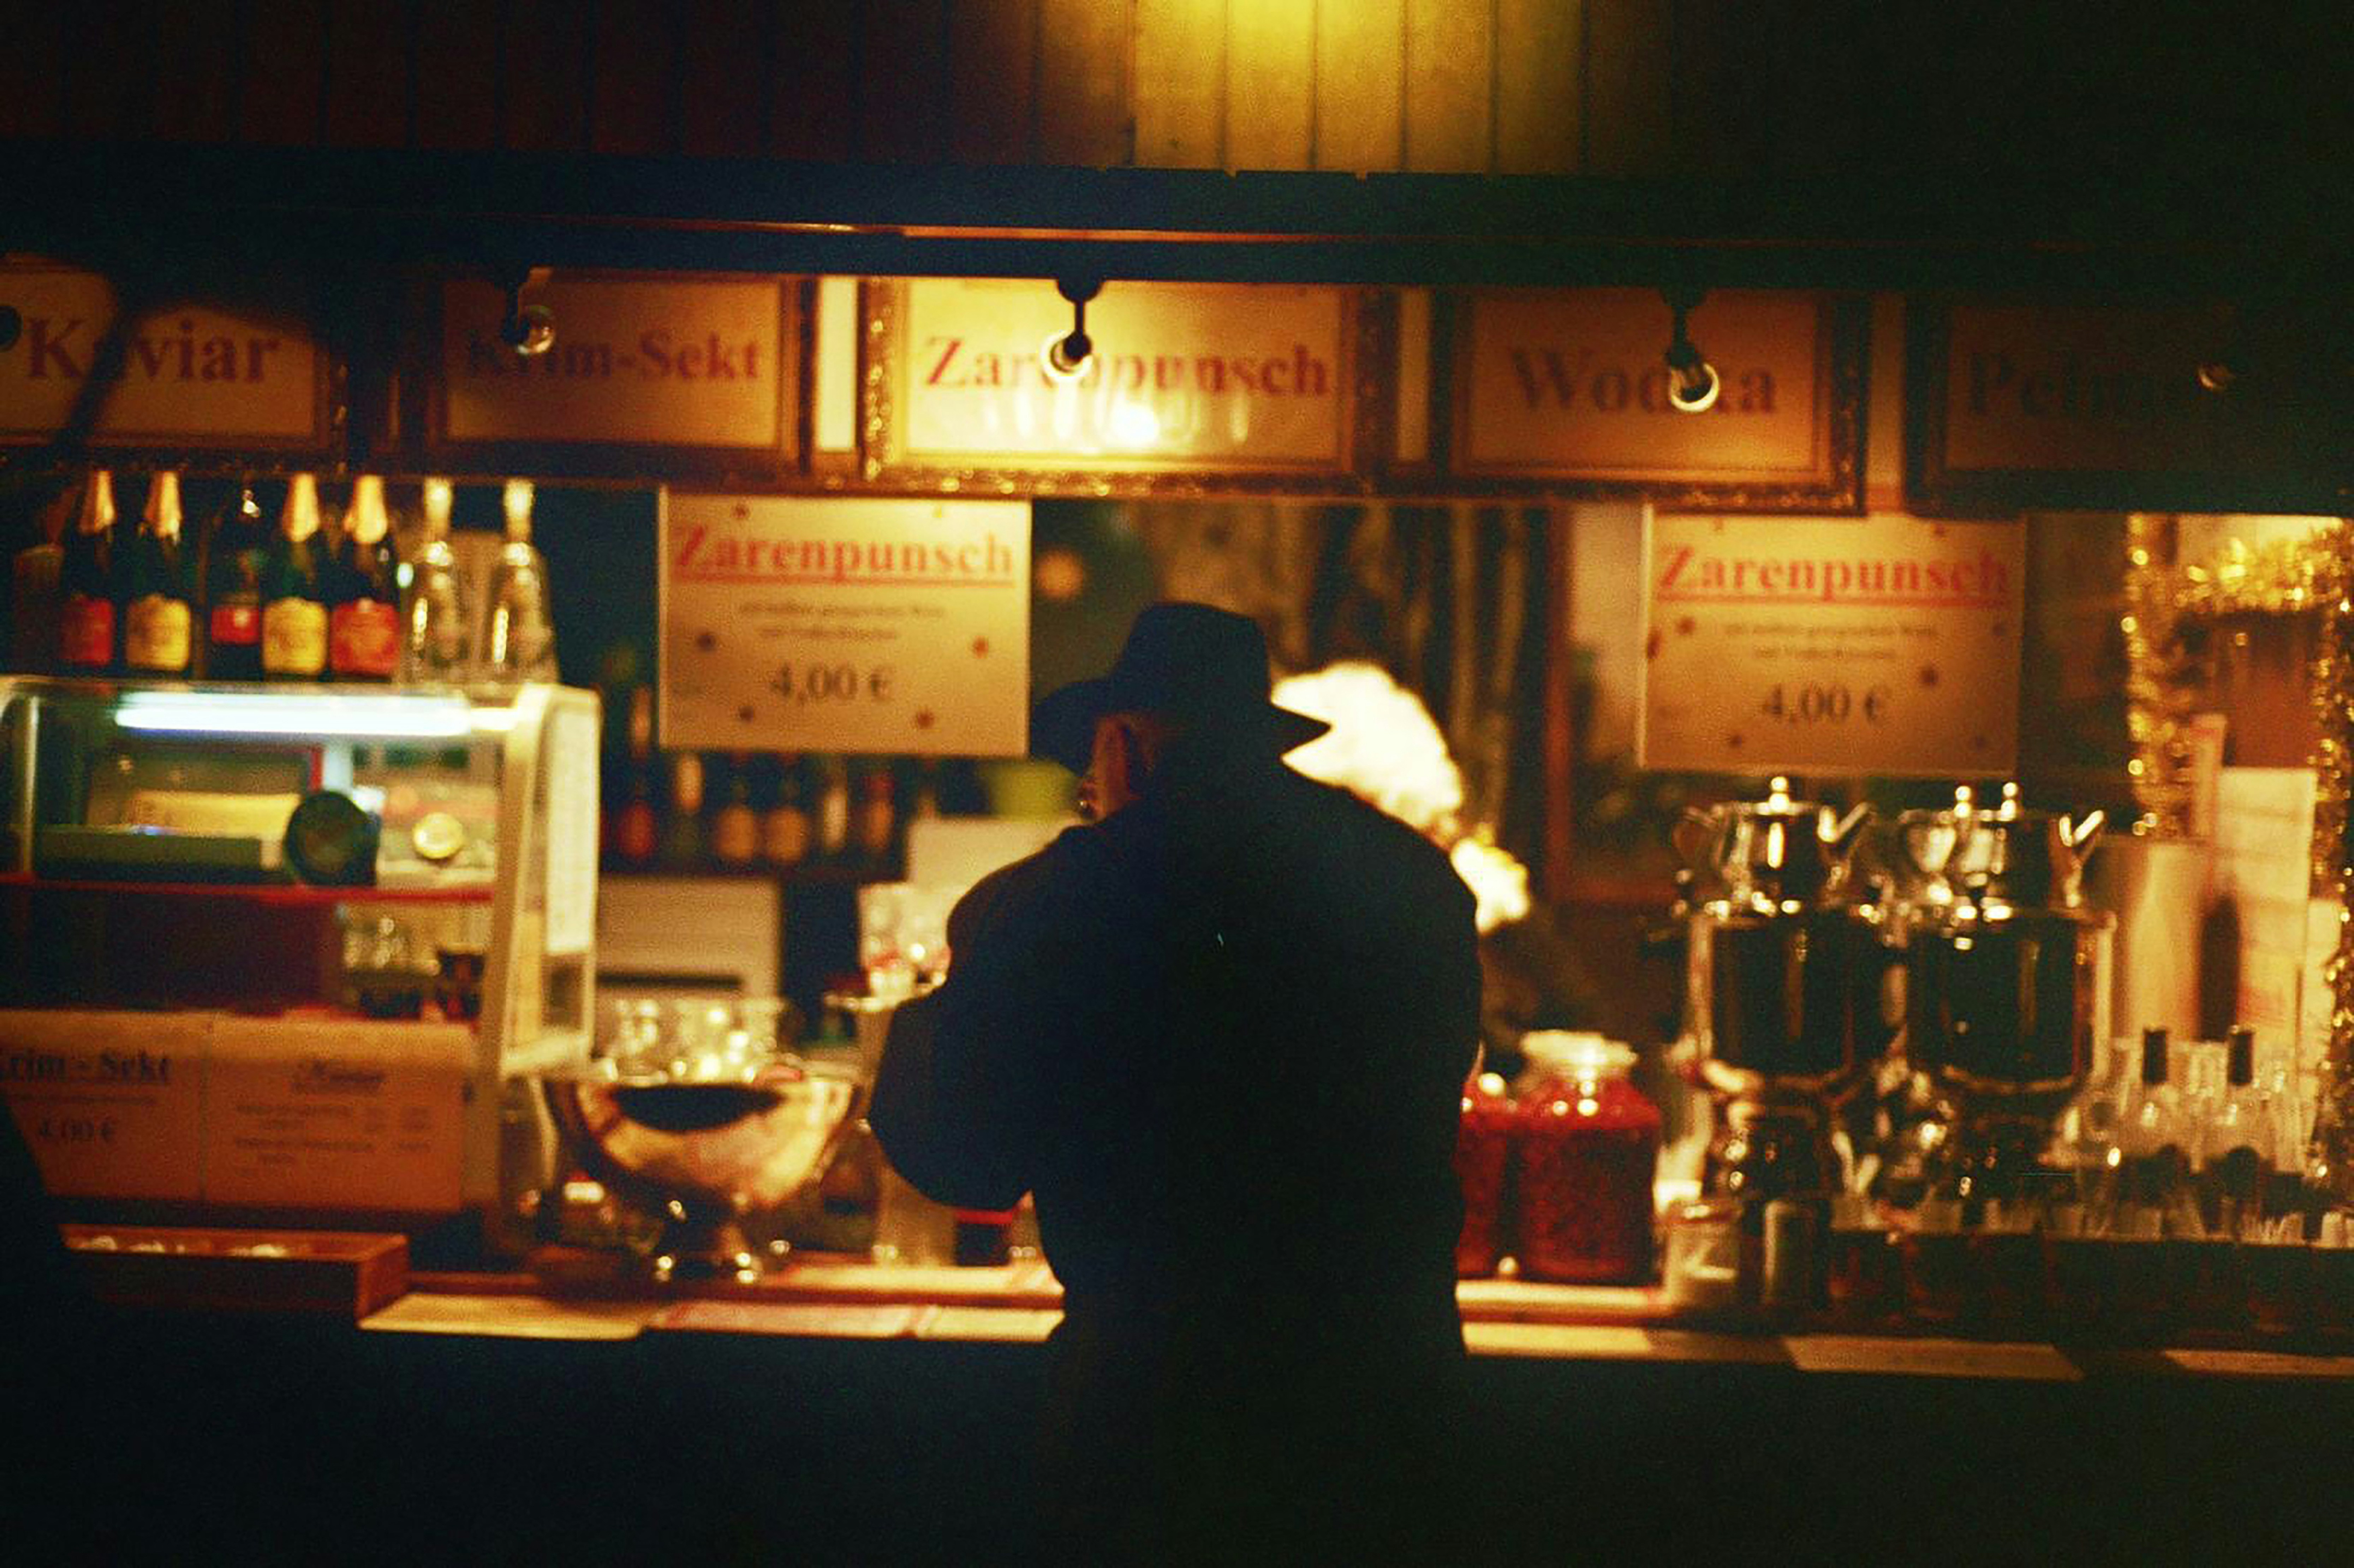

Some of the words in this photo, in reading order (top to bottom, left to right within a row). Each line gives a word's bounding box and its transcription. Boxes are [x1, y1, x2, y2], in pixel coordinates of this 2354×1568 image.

[26, 317, 281, 382] Kviar
[926, 335, 1327, 396] Zarnpunsch
[1508, 348, 1777, 413] Woda
[670, 519, 1013, 584] Zarenpunsch
[1657, 546, 2008, 602] Zarenpunsch
[770, 662, 857, 704] 4,00
[868, 665, 893, 702] €
[1764, 684, 1852, 725] 4,00
[0, 1048, 66, 1082] rim
